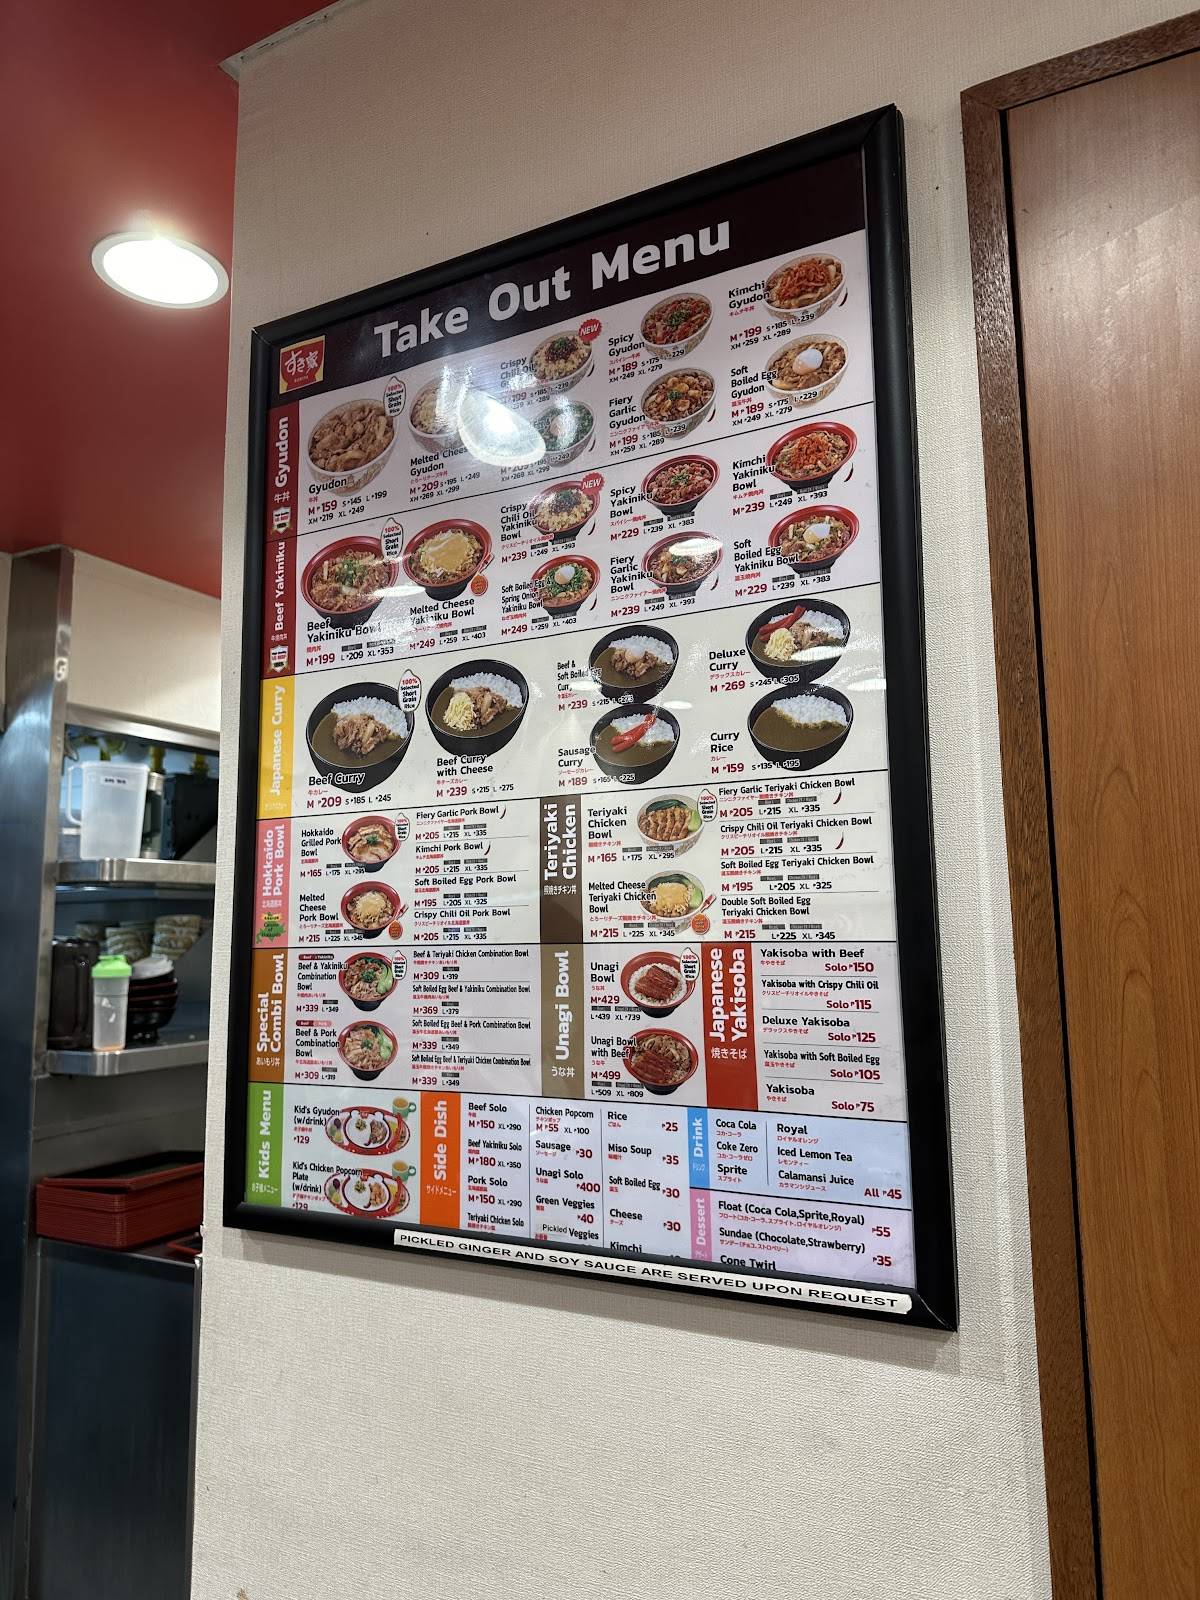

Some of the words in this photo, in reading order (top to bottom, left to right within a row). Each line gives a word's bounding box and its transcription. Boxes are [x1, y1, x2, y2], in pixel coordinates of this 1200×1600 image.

[374, 305, 469, 358] Take
[488, 266, 571, 321] Out
[591, 220, 730, 290] Menu
[728, 281, 765, 299] Kimchi
[728, 291, 770, 310] Gyudon
[581, 324, 598, 336] NEW
[608, 333, 634, 347] Spicy
[608, 341, 645, 357] Gyudon
[730, 366, 748, 377] Soft
[731, 374, 758, 388] Boiled
[761, 370, 776, 381] Egg
[731, 384, 764, 400] Gyudon
[609, 396, 632, 408] Fiery
[609, 405, 636, 418] Garlic
[609, 414, 646, 430] Gyudon
[275, 416, 288, 488] Gyudon
[732, 455, 766, 470] Kimchi
[732, 465, 775, 481] Yakiniku
[308, 476, 347, 494] Gyudon
[583, 479, 600, 489] NEW
[732, 479, 757, 492] Bowl
[610, 486, 636, 497] Spicy
[610, 492, 652, 507] Yakiniku
[610, 506, 633, 518] Bowl
[276, 542, 286, 599] Yakiniku
[410, 605, 439, 616] Melted
[442, 598, 475, 610] Cheese
[275, 604, 284, 631] Beef
[307, 619, 330, 631] Beef
[307, 628, 351, 643] Yakiniku
[709, 647, 746, 660] Deluxe
[709, 661, 738, 673] Curry
[272, 686, 285, 722] Curry
[710, 731, 740, 743] Curry
[710, 743, 734, 753] Rice
[270, 730, 282, 796] Japanese
[437, 757, 457, 767] Beef
[460, 754, 486, 765] Curry
[437, 767, 457, 777] with
[460, 764, 493, 775] Cheese
[309, 775, 332, 786] Beef
[334, 772, 365, 785] Curry
[719, 787, 738, 796] Fiery
[765, 782, 797, 792] Teriyaki
[800, 780, 832, 789] Chicken
[835, 778, 855, 786] Bowl
[588, 806, 627, 818] Teriyaki
[588, 819, 626, 828] Chicken
[274, 824, 284, 859] Bowl
[544, 803, 560, 880] Teriyaki
[563, 804, 576, 879] Chicken
[588, 831, 612, 839] Bowl
[262, 830, 273, 896] Hokkaido
[273, 864, 284, 896] Pork
[761, 949, 808, 958] Yakisoba
[812, 949, 835, 958] with
[840, 949, 864, 958] Beef
[272, 953, 284, 994] Bowl
[591, 962, 619, 972] Unagi
[825, 963, 847, 972] Solo
[555, 951, 569, 997] Bowl
[591, 974, 615, 982] Bowl
[762, 980, 796, 988] Yakisoba
[799, 980, 815, 988] with
[818, 980, 843, 990] Crispy
[846, 980, 864, 989] Chili
[867, 981, 879, 989] Oil
[710, 948, 729, 1042] Japanese
[729, 949, 746, 1041] Yakisoba
[827, 1000, 849, 1009] Solo
[256, 992, 270, 1053] Special
[270, 999, 284, 1053] Combi
[763, 1016, 797, 1025] Deluxe
[801, 1017, 850, 1027] Yakisoba
[555, 1004, 572, 1060] Unagi
[828, 1033, 850, 1041] Solo
[711, 1047, 747, 1059] 焼きそば
[764, 1050, 797, 1060] Yakisoba
[801, 1051, 817, 1060] with
[819, 1052, 835, 1061] Soft
[837, 1053, 863, 1063] Boiled
[866, 1055, 880, 1065] Egg
[552, 1067, 575, 1077] うな丼
[831, 1069, 853, 1078] Solo
[766, 1084, 814, 1095] Yakisoba
[294, 1106, 311, 1114] Kid's
[313, 1107, 340, 1116] Gyudon
[469, 1103, 487, 1111] Beef
[489, 1103, 507, 1112] Solo
[832, 1101, 854, 1110] Solo
[260, 1089, 271, 1136] Menu
[434, 1100, 447, 1137] Dish
[536, 1107, 563, 1116] Chicken
[565, 1109, 594, 1120] Popcorn
[607, 1112, 627, 1121] Rice
[294, 1116, 326, 1126] (w/drink)
[716, 1119, 735, 1129] Coca
[738, 1121, 756, 1130] Cola
[777, 1124, 808, 1135] Royal
[694, 1118, 703, 1157] Drink
[536, 1141, 571, 1152] Sausage
[608, 1144, 627, 1153] Miso
[630, 1146, 652, 1156] Soup
[717, 1142, 736, 1151] Coke
[739, 1143, 758, 1153] Zero
[259, 1143, 271, 1178] Kids
[777, 1147, 797, 1157] Iced
[800, 1149, 831, 1160] Lemon
[834, 1152, 852, 1162] Tea
[434, 1144, 447, 1180] Side
[536, 1168, 561, 1179] Unagi
[564, 1170, 583, 1179] Solo
[718, 1164, 748, 1175] Sprite
[468, 1176, 486, 1184] Pork
[489, 1177, 507, 1186] Solo
[609, 1176, 623, 1185] Soft
[624, 1177, 646, 1187] Boiled
[649, 1180, 660, 1190] Egg
[779, 1170, 826, 1183] Calamansi
[829, 1175, 854, 1186] Juice
[865, 1188, 880, 1197] All
[536, 1195, 559, 1205] Green
[562, 1197, 595, 1210] Veggies
[718, 1201, 742, 1212] Float
[610, 1209, 643, 1220] Cheese
[697, 1199, 705, 1246] Dessert
[542, 1224, 567, 1234] Pickled
[569, 1228, 599, 1240] Veggies
[720, 1228, 752, 1240] Sundae
[720, 1255, 746, 1267] Cone
[749, 1258, 776, 1271] Twirl
[400, 1234, 454, 1248] PICKLED
[458, 1243, 511, 1257] GINGER
[515, 1251, 544, 1261] AND
[549, 1255, 579, 1265] SOY
[584, 1260, 636, 1273] SAUCE
[641, 1268, 672, 1278] ARE
[678, 1272, 747, 1288] SERVED
[752, 1282, 802, 1295] UPON
[808, 1289, 898, 1307] REQUEST
